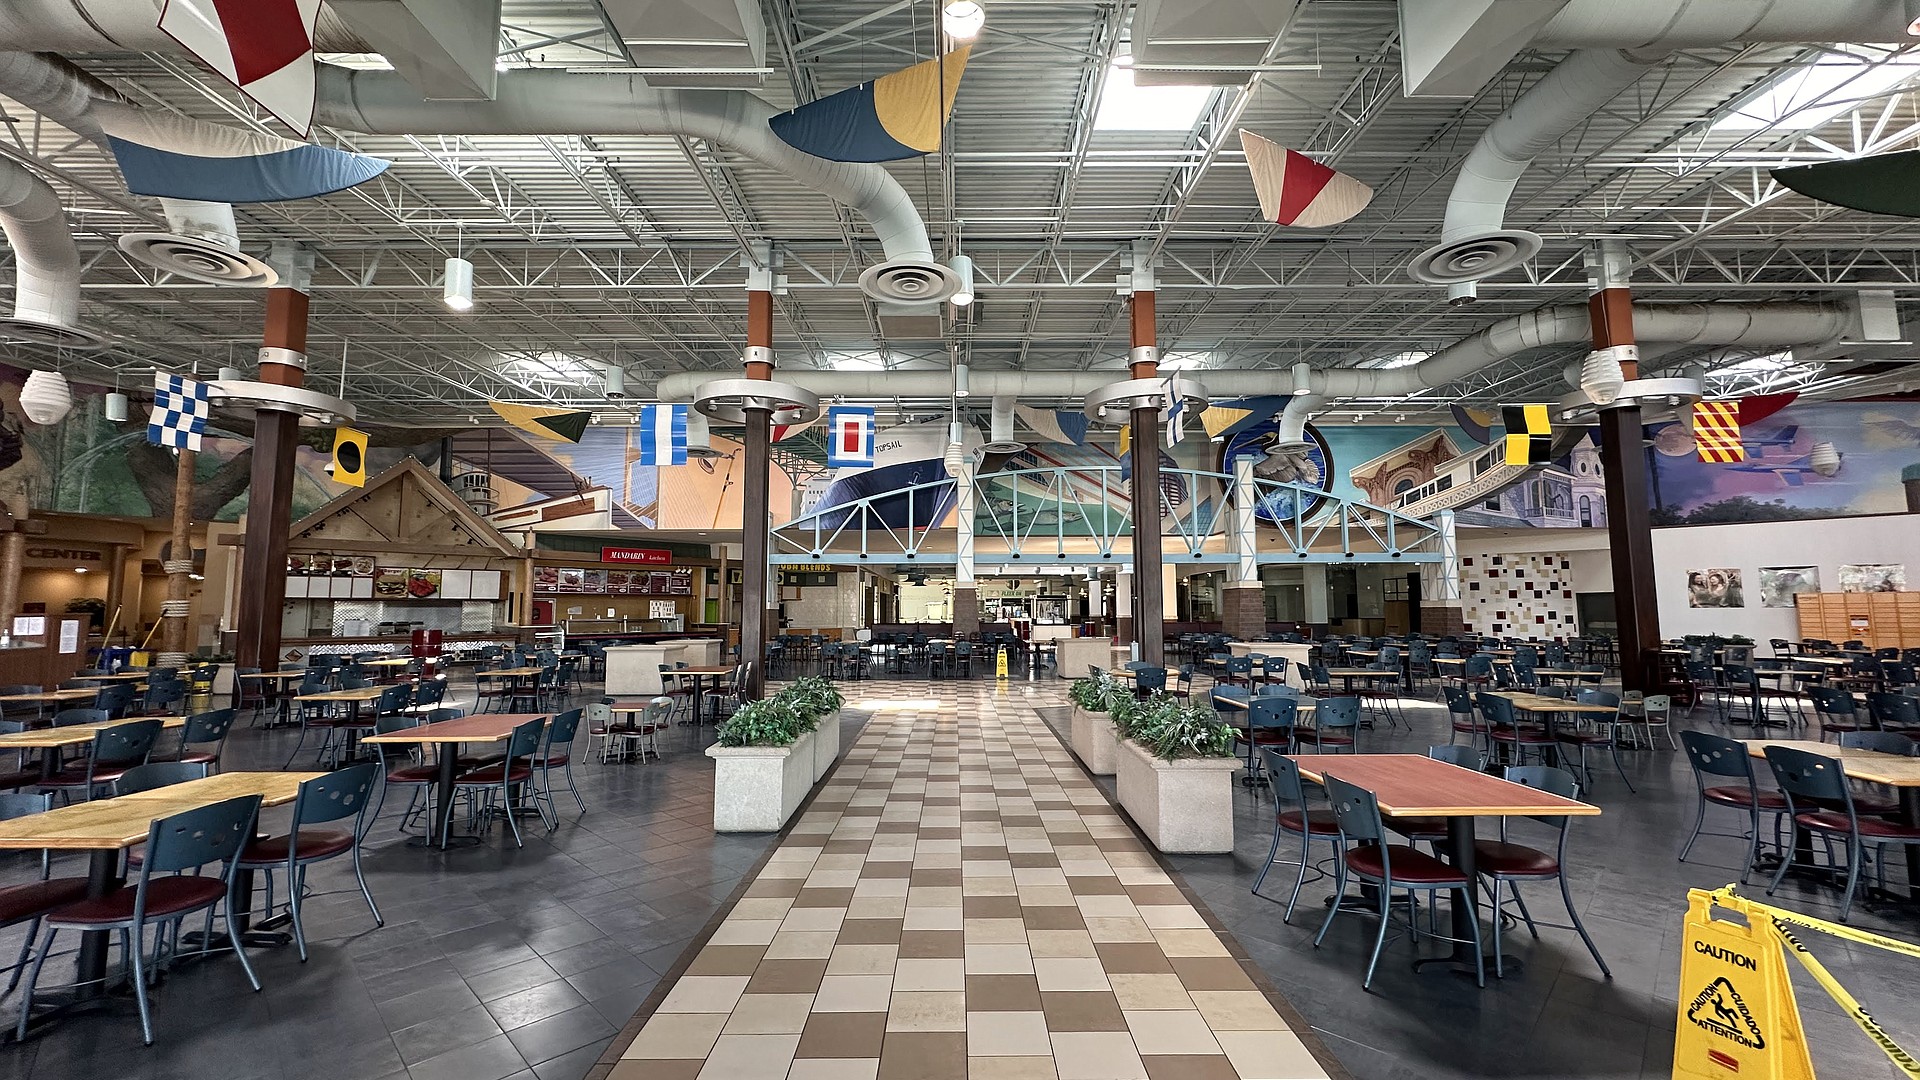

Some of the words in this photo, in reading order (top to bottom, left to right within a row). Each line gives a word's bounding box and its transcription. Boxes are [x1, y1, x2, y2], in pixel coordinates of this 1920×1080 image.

[875, 440, 902, 453] TOPSAIL
[25, 548, 102, 560] CENTER
[609, 551, 645, 560] MANDARIN
[1694, 940, 1757, 972] CAUTION
[1690, 982, 1718, 1012] CAUTION
[1730, 992, 1761, 1035] CUIDADO
[1697, 1019, 1753, 1048] ATTENTION
